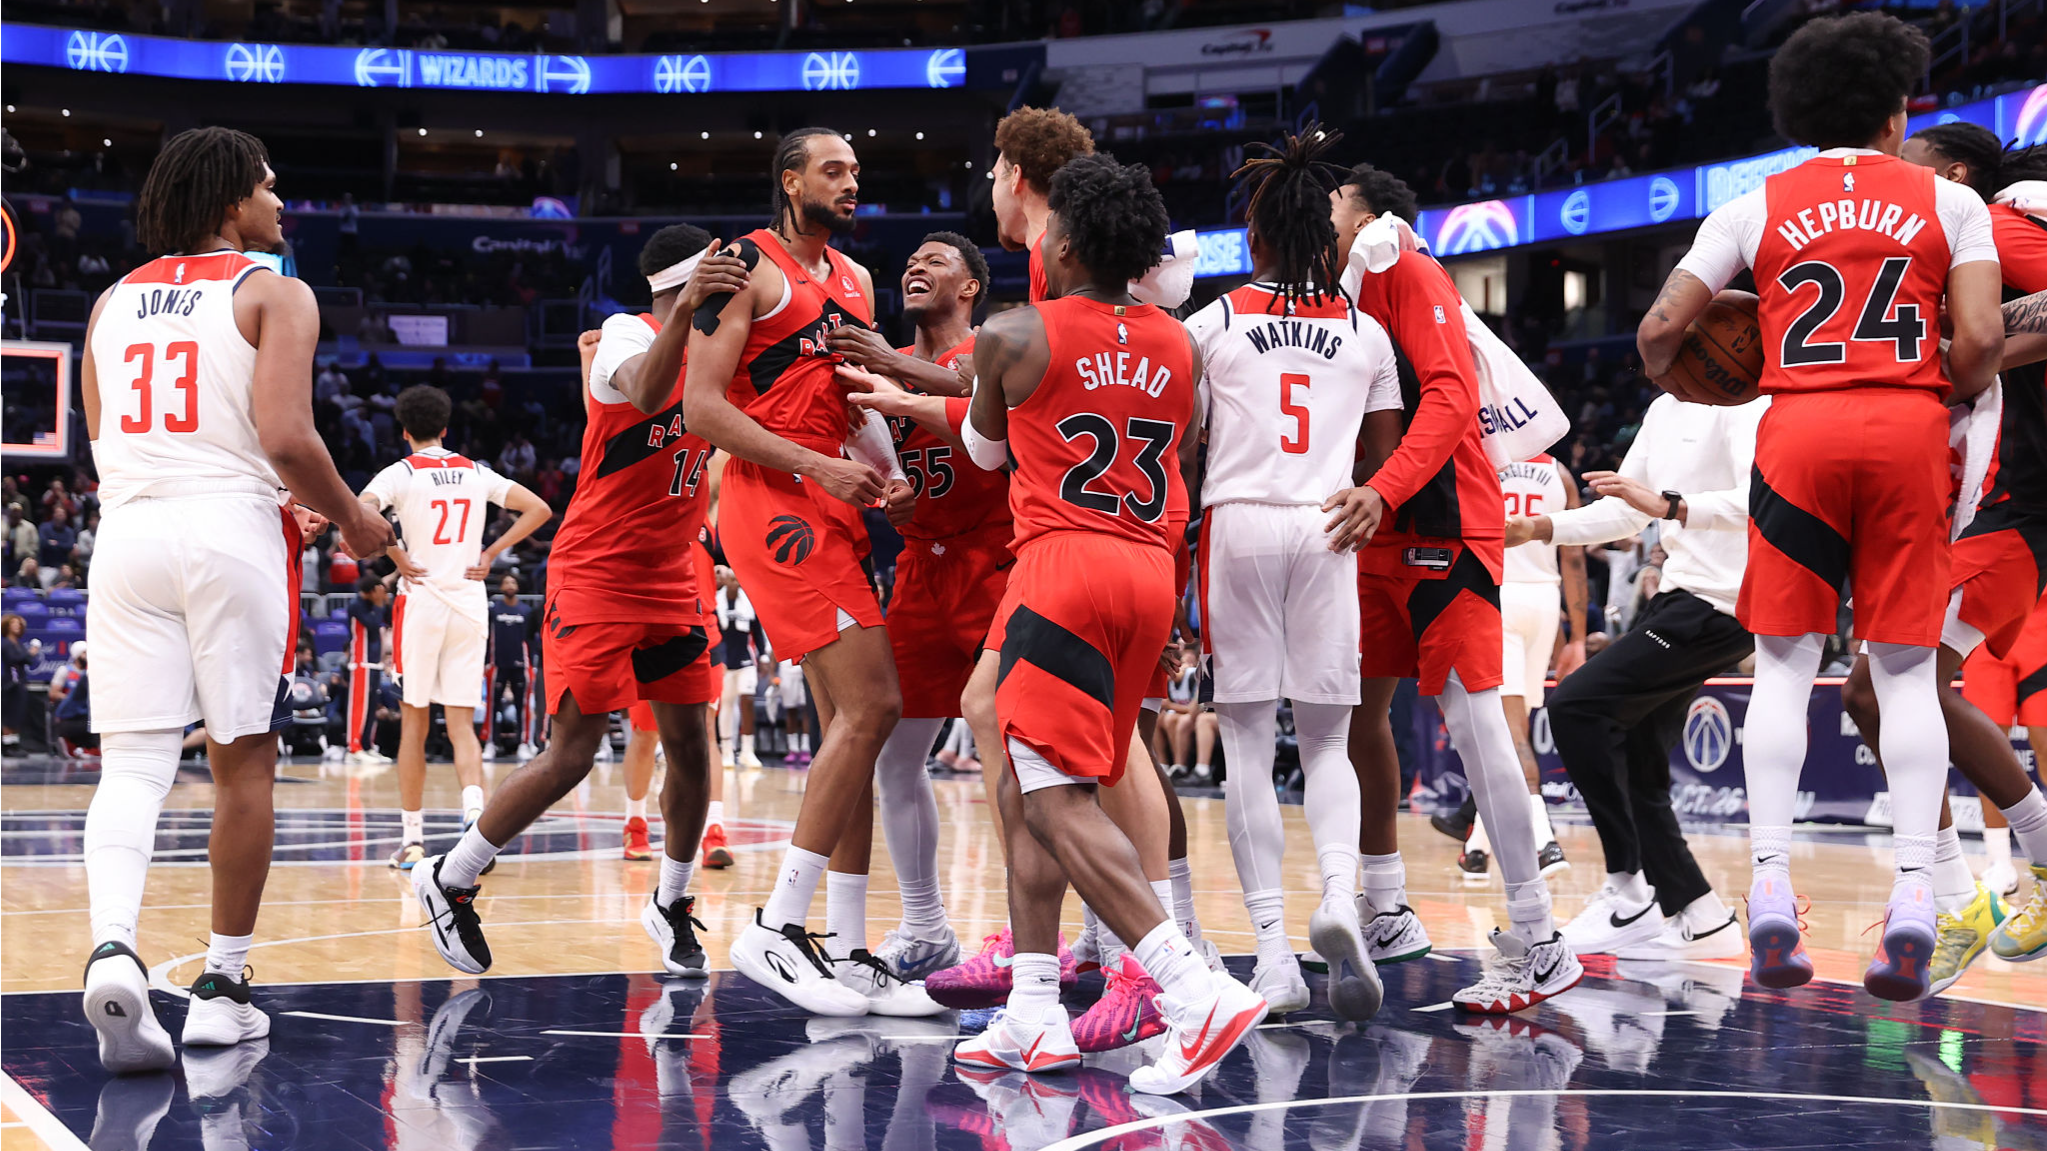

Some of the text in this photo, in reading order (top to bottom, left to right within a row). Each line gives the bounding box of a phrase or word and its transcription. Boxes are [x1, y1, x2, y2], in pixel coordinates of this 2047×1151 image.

[419, 54, 529, 89] WIZARDS
[1777, 199, 1927, 251] HEPBURN
[1194, 232, 1241, 274] ISE
[1776, 256, 1927, 368] 24
[1246, 321, 1342, 360] WATKINS
[121, 340, 199, 433] 33
[1076, 351, 1171, 398] SHEAD
[1280, 373, 1310, 454] 5
[431, 470, 464, 487] RILEY
[669, 448, 707, 497] 14
[899, 446, 955, 500] 55
[1055, 412, 1175, 523] 23
[431, 498, 471, 546] 27
